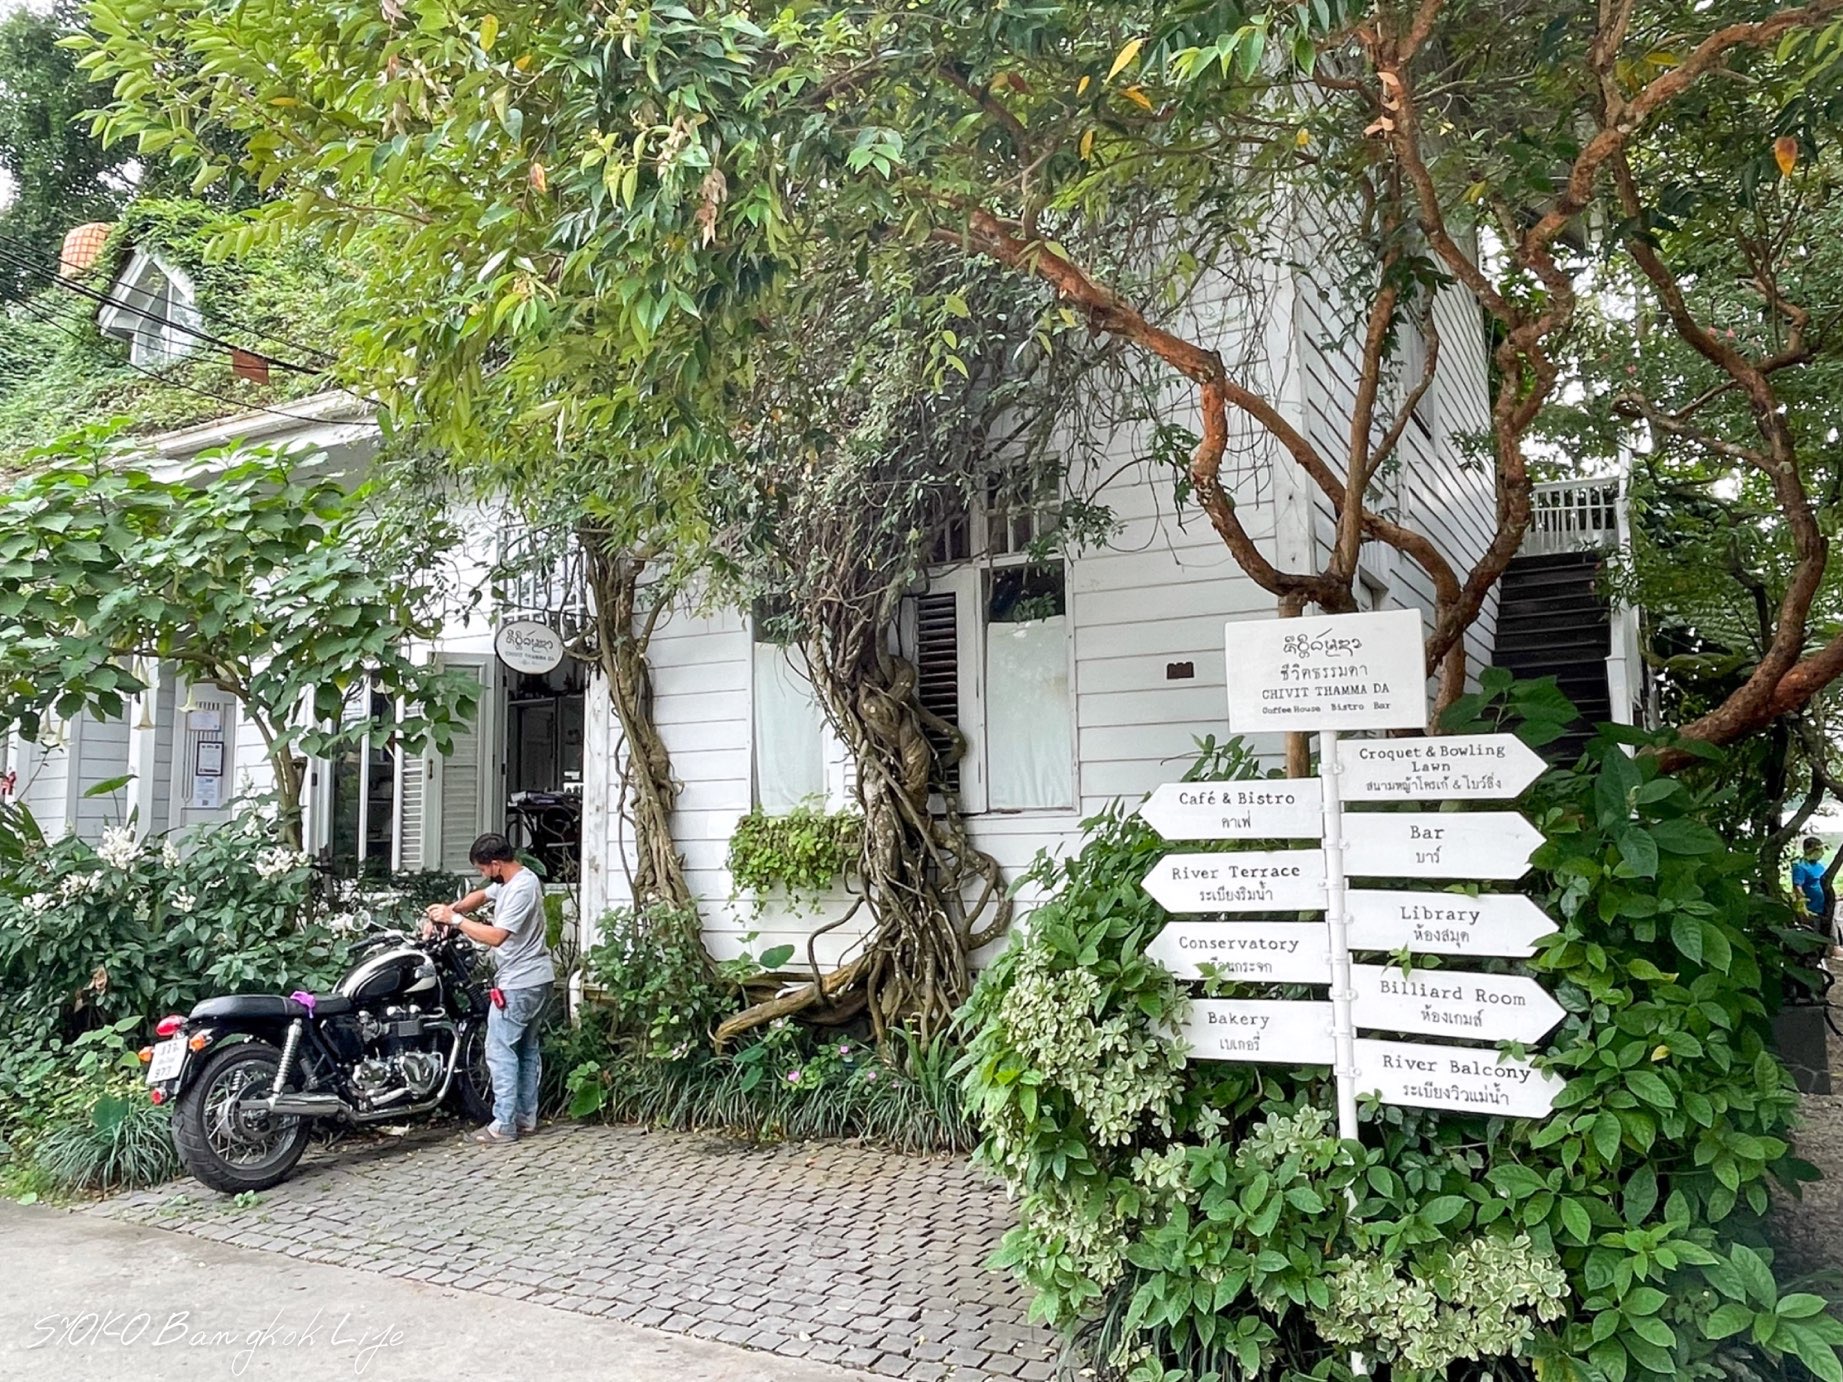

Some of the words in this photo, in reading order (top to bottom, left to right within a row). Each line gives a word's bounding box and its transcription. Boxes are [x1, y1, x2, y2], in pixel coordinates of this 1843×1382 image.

[1262, 687, 1309, 699] CHIVIT
[1315, 685, 1367, 696] THAMMA
[1373, 683, 1389, 693] DA
[1331, 703, 1364, 711] Bistro
[1359, 746, 1422, 761] Croquet
[1426, 746, 1436, 757] &
[1440, 744, 1505, 758] Bowling
[1411, 761, 1450, 772] Lawn
[1453, 780, 1461, 789] &
[1179, 791, 1215, 805] Café
[1222, 792, 1231, 804] &
[1238, 791, 1295, 805] Bistro
[1222, 810, 1251, 828] คาเฟ่
[1410, 825, 1445, 839] Bar
[1416, 845, 1442, 863] บาร์
[1172, 867, 1218, 880] River
[1229, 866, 1300, 878] Terrace
[1200, 880, 1273, 901] ระเบียงริมน้ำ
[1400, 906, 1480, 926] Library
[1179, 936, 1299, 953] Conservatory
[1380, 979, 1462, 1000] Billiard
[1475, 989, 1526, 1006] Room
[1207, 1012, 1269, 1029] Bakery
[1421, 1004, 1484, 1027] ห้องเกมส์
[1220, 1031, 1260, 1051] เบเกอรี่
[1383, 1055, 1437, 1072] River
[1450, 1060, 1531, 1083] Balcony
[1403, 1082, 1509, 1106] ระเบียงวิวแม่น้ำ
